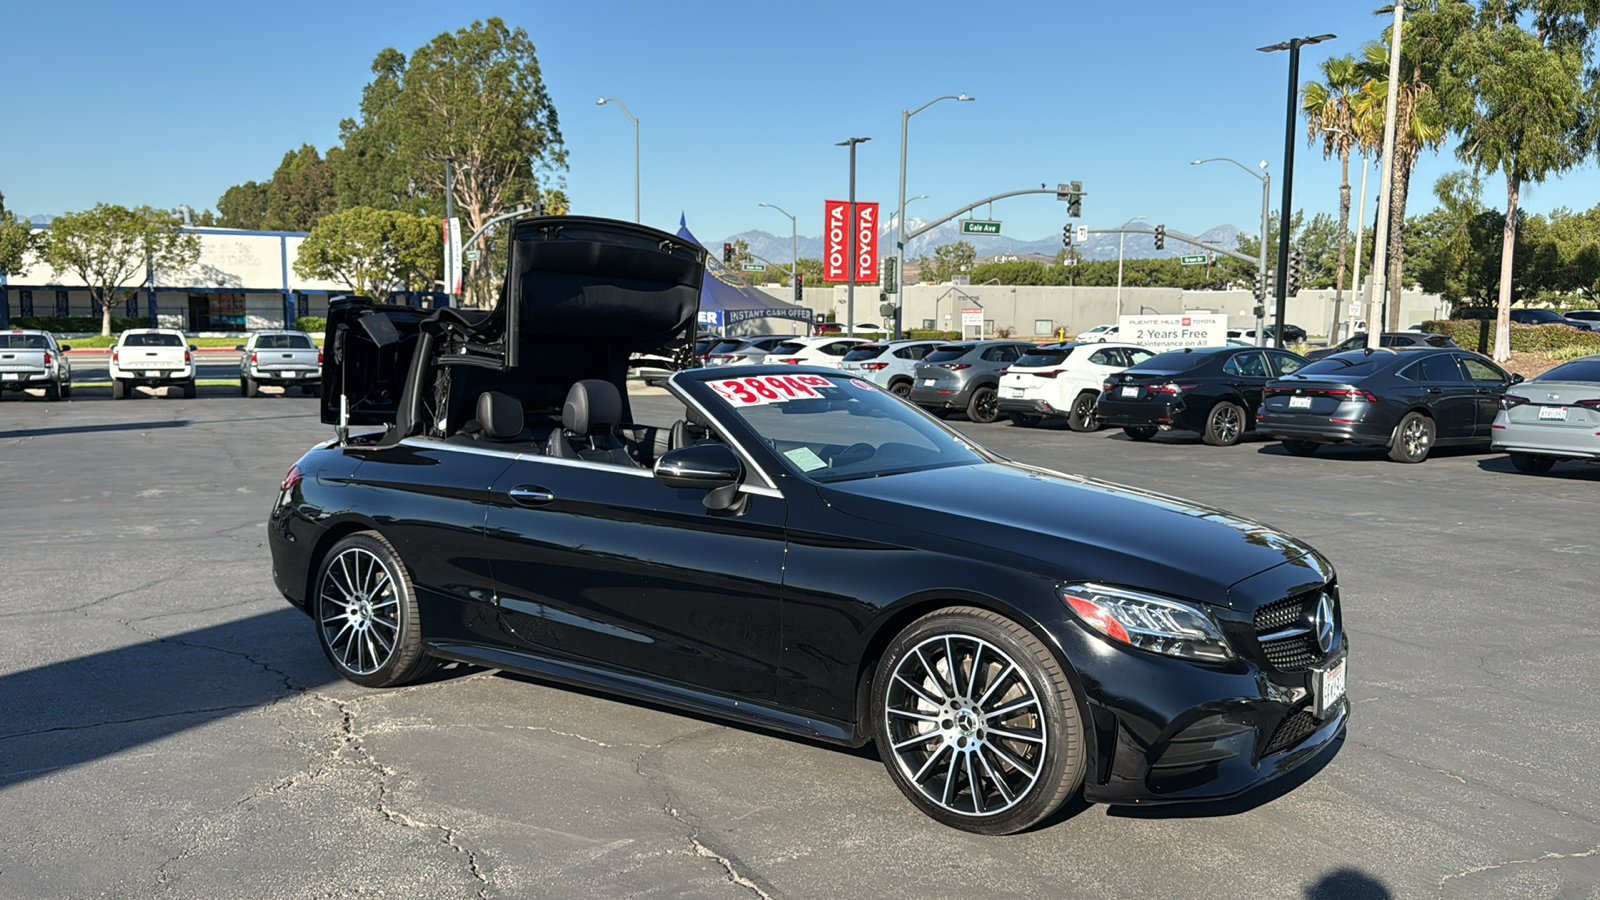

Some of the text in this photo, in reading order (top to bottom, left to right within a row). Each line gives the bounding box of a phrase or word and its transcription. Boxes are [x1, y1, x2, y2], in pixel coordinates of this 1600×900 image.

[968, 223, 996, 232] Gale Ave
[830, 205, 844, 278] TOYOTA
[859, 207, 873, 279] TOYOTA
[730, 309, 811, 323] INSTANT CASH OFFER
[1136, 329, 1208, 339] 2 Years Free
